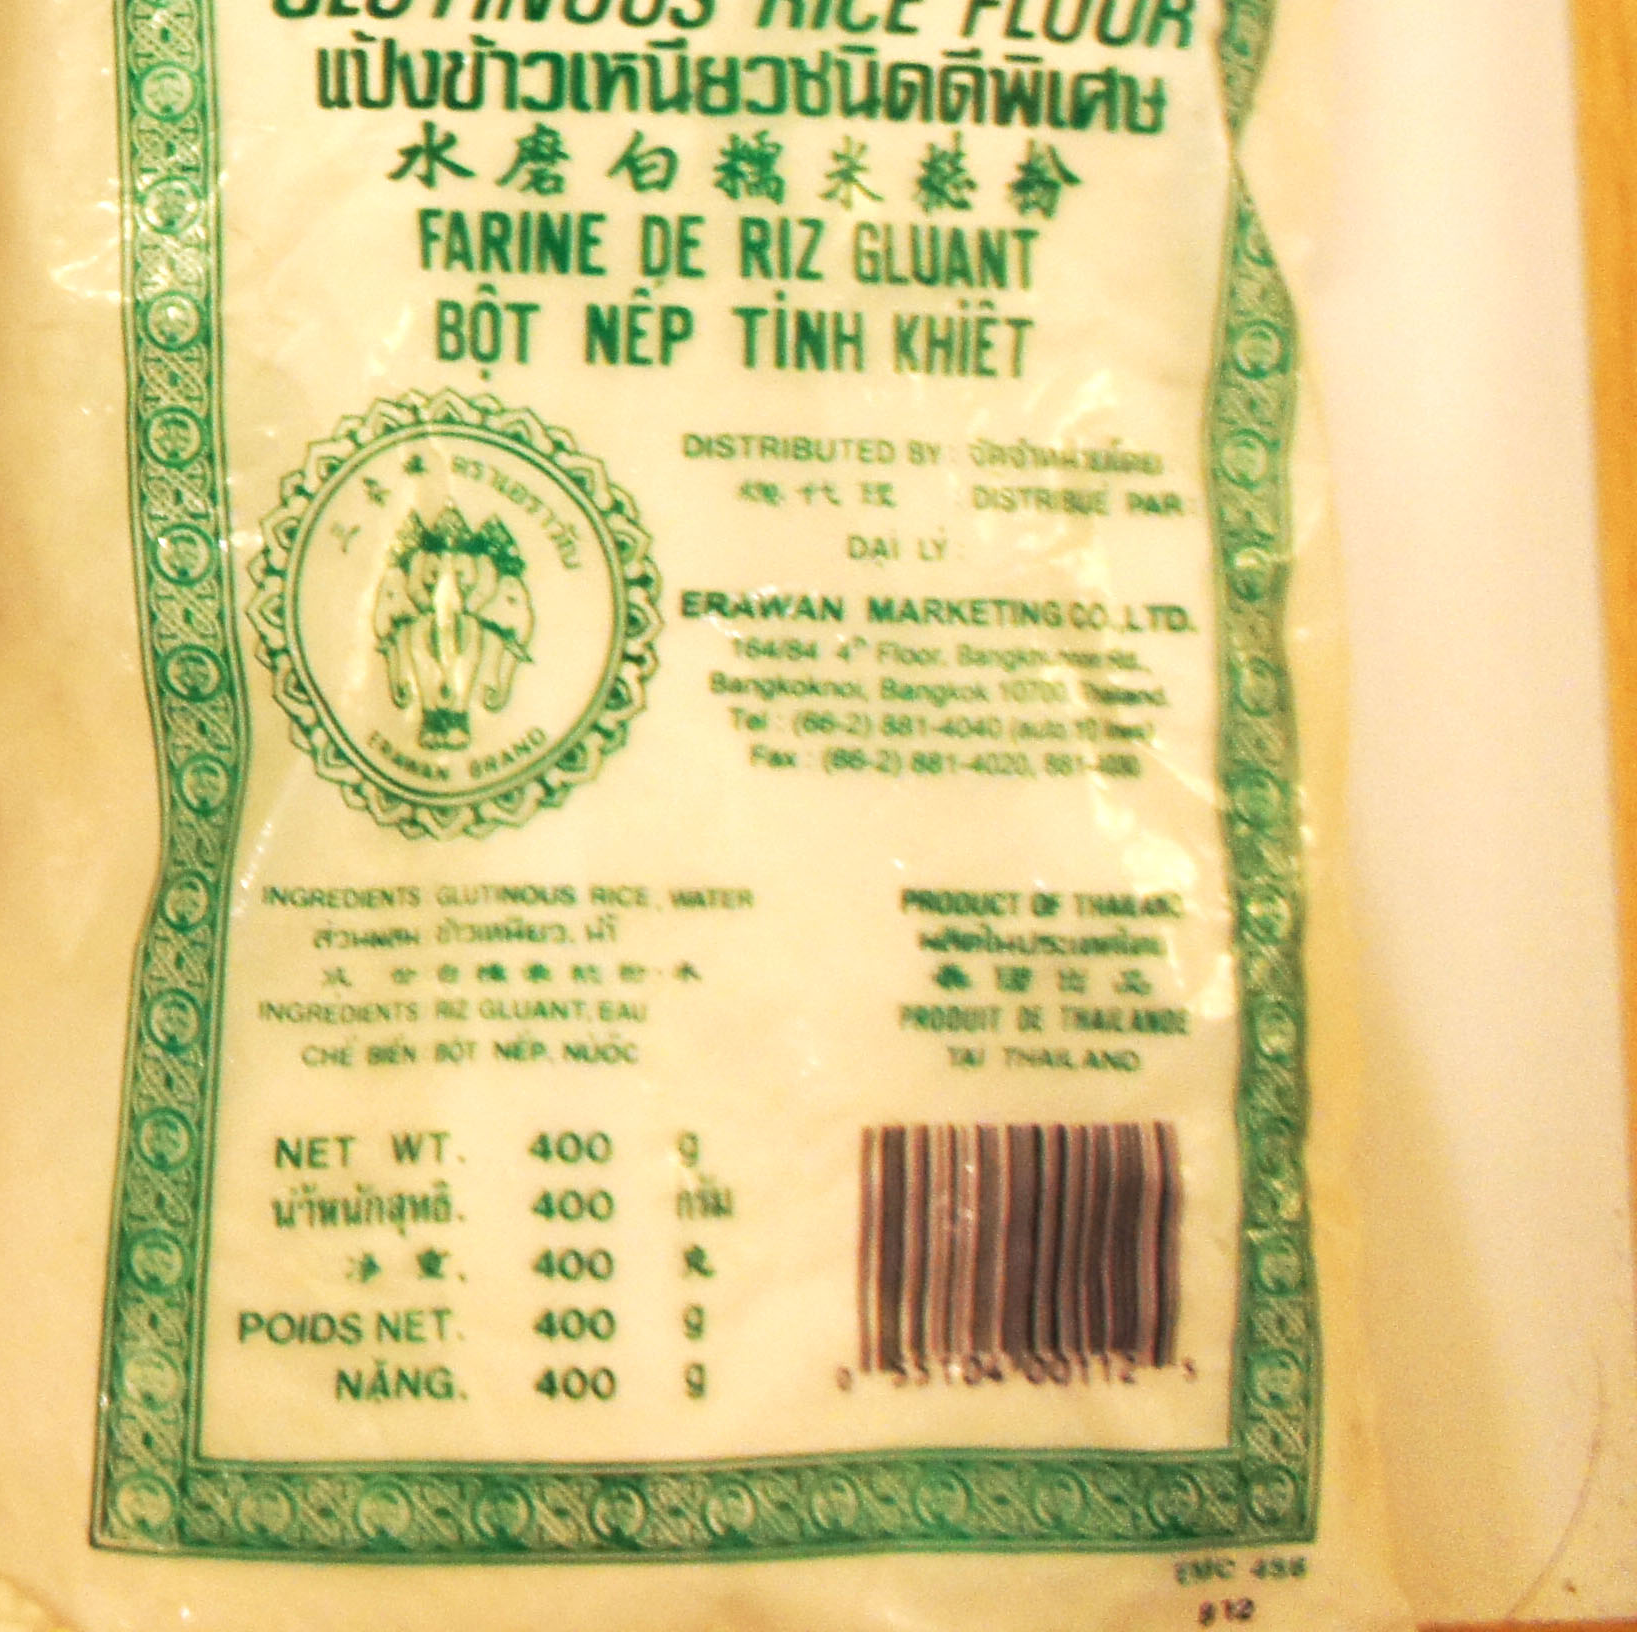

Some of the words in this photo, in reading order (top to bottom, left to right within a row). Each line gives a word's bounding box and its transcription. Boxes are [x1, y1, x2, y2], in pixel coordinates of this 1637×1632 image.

[418, 209, 607, 276] FARINE
[641, 213, 707, 279] DE
[739, 216, 826, 282] RIZ
[854, 221, 1040, 290] GLUANT
[681, 432, 896, 467] DISTRIBUTED
[680, 589, 846, 622] ERAWAN
[867, 596, 1064, 629] MARKETING
[435, 884, 577, 908] GLUTINOUS
[668, 887, 755, 911] WATER
[598, 1001, 648, 1024] EAU
[273, 1133, 358, 1170] NET
[390, 1130, 468, 1167] WT.
[527, 1130, 614, 1165] 400
[677, 1130, 702, 1169] g
[531, 1187, 617, 1224] 400
[532, 1247, 617, 1283] 400
[237, 1309, 364, 1348] POIDS
[376, 1307, 467, 1345] NET.
[532, 1306, 618, 1343] 400
[682, 1303, 706, 1343] g
[532, 1366, 618, 1403] 400
[683, 1361, 708, 1403] g
